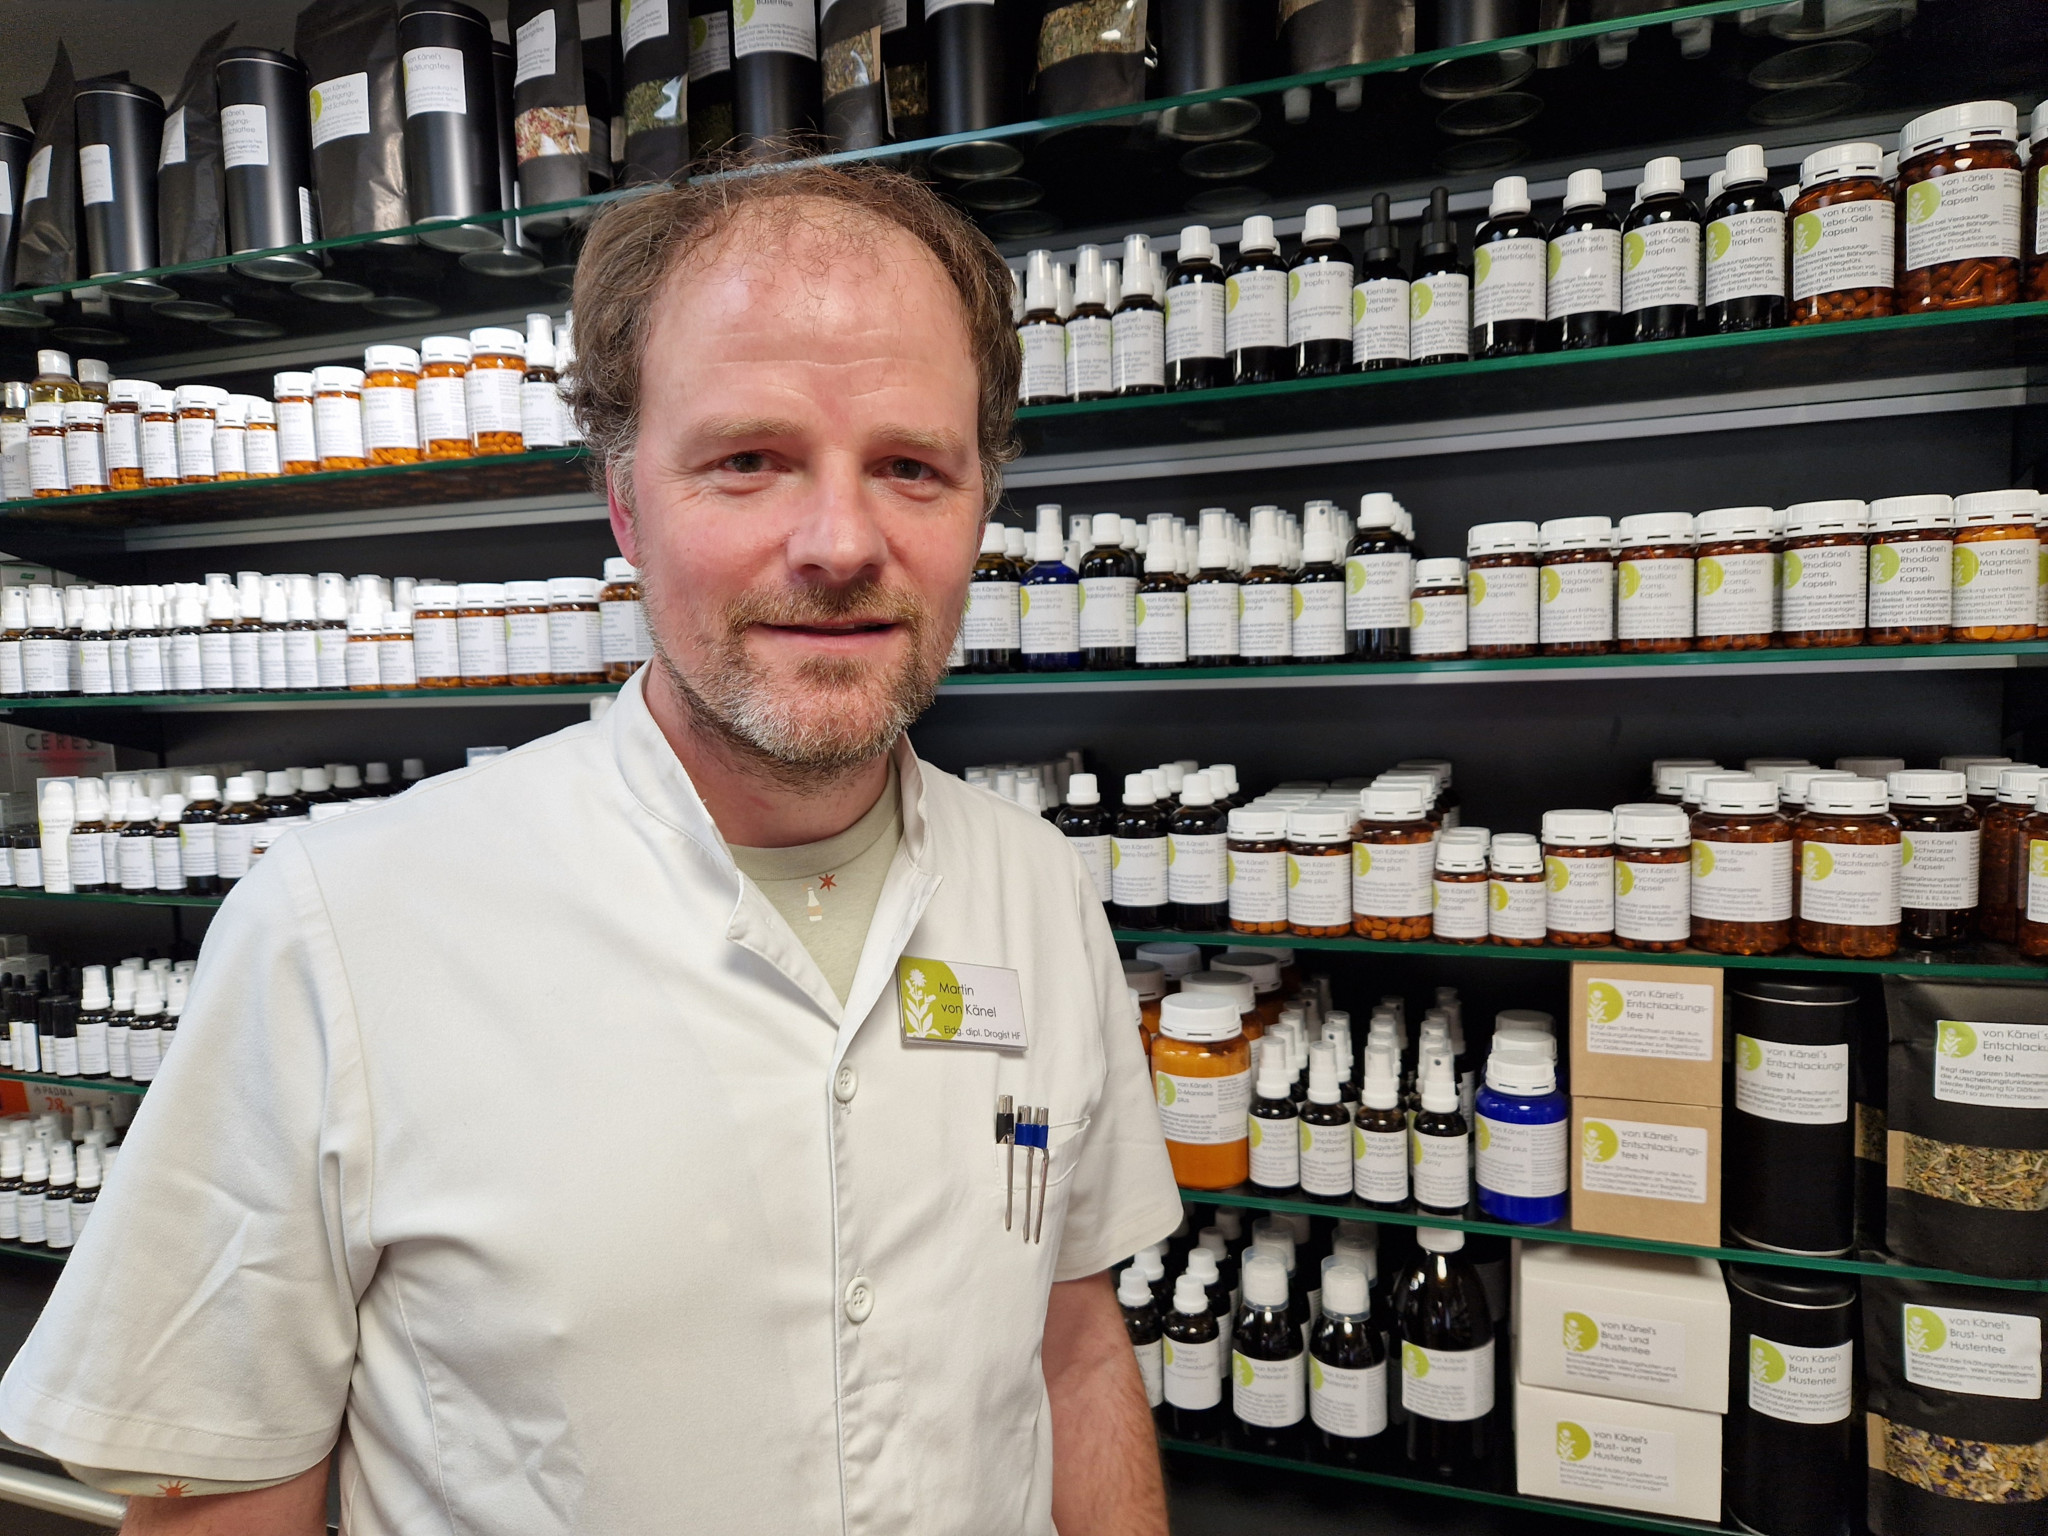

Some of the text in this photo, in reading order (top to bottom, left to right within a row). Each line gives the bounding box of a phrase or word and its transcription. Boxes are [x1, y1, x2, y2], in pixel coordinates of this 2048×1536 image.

[1941, 183, 1996, 197] Leber-Galle
[1941, 195, 1979, 207] Kapseln
[1841, 204, 1872, 214] Känel's
[1822, 214, 1874, 228] Leber-Galle
[1731, 226, 1778, 237] Leber-Galle
[1822, 226, 1858, 238] Kapseln
[1645, 236, 1691, 247] Leber-Galle
[1731, 237, 1764, 247] Tropfen
[1645, 246, 1676, 257] Tropfen
[1802, 560, 1842, 569] Rhodiola
[1900, 555, 1940, 564] Rhodiola
[1802, 571, 1832, 580] comp.
[1900, 566, 1931, 575] comp.
[1979, 568, 2023, 577] Tabletten
[1802, 580, 1838, 589] Kapseln
[1900, 575, 1936, 584] Kapseln
[1486, 591, 1516, 599] Kapseln
[1560, 586, 1592, 595] Kapseln
[939, 982, 975, 996] Martin
[1626, 990, 1684, 1000] von Känel's
[941, 1004, 997, 1018] von Känel
[1626, 1000, 1709, 1013] Entschlackungs-
[1626, 1011, 1655, 1020] tee N
[943, 1025, 1021, 1040] Eidg. dipl. Drogist HF
[1982, 1029, 2004, 1038] von
[1766, 1048, 1787, 1057] von
[1983, 1053, 2014, 1062] tee N
[1766, 1069, 1784, 1079] tee
[1621, 1130, 1641, 1139] von
[1621, 1139, 1704, 1156] Entschlackungs-
[1621, 1151, 1649, 1160] tee N
[1601, 1322, 1657, 1336] von Känel's
[1949, 1317, 2012, 1331] von Känel's
[1601, 1331, 1650, 1345] Brust- und
[1949, 1328, 2004, 1342] Brust- und
[1600, 1341, 1651, 1355] Hustentee
[1950, 1341, 2007, 1355] Hustentee
[1788, 1352, 1842, 1363] von Känel's
[1788, 1363, 1837, 1375] Brust- und
[1788, 1375, 1838, 1386] Hustentee
[1593, 1431, 1649, 1445] von Känel's
[1593, 1440, 1641, 1454] Brust- und
[1593, 1451, 1643, 1465] Hustentee
